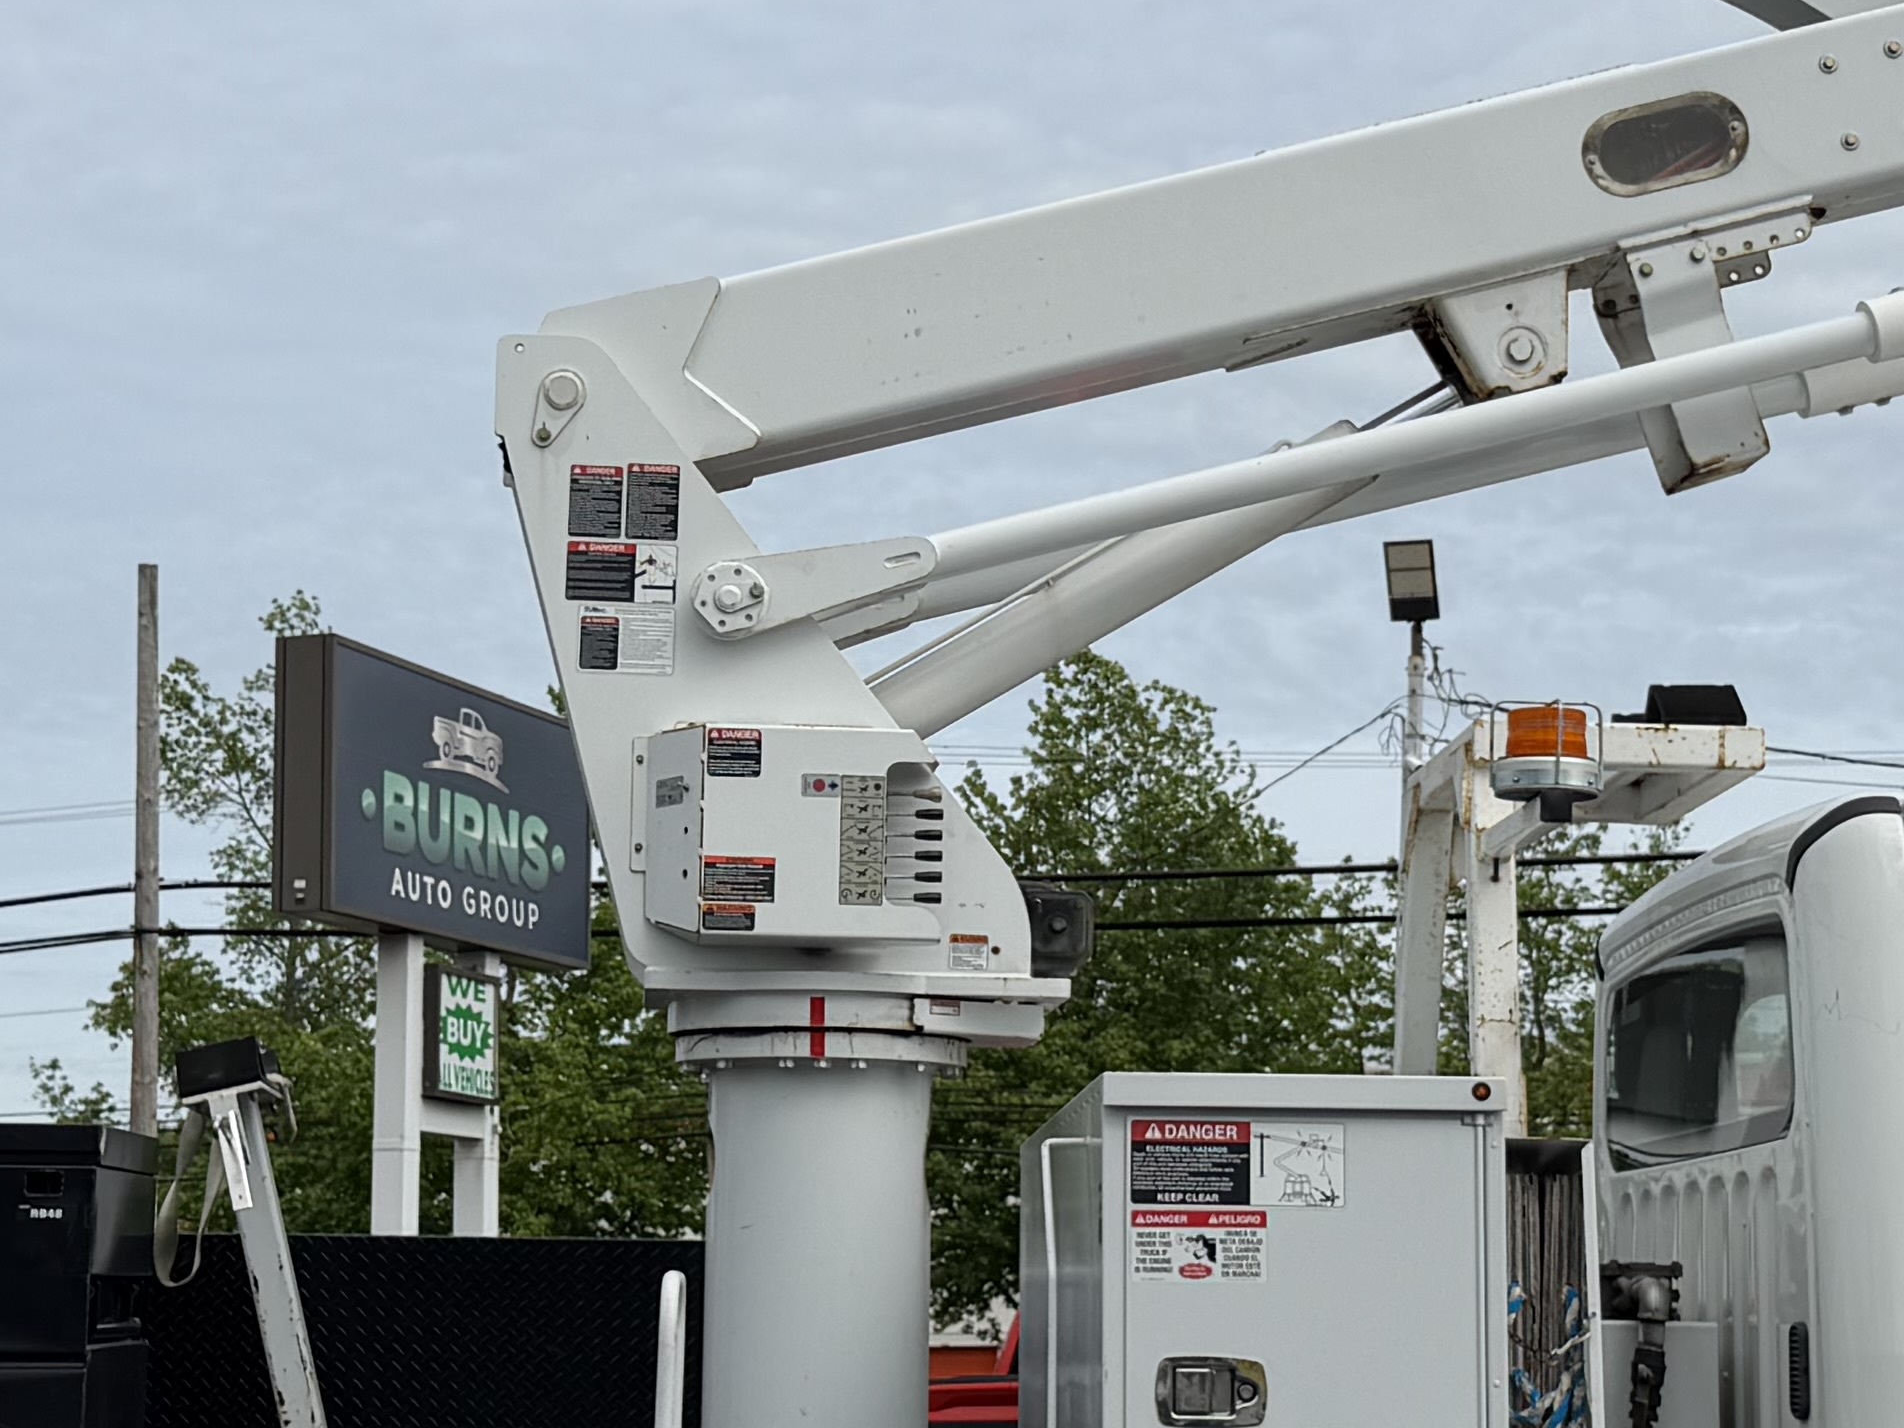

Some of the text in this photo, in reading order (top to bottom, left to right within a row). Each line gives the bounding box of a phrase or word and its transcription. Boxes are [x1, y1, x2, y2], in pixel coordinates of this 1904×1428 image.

[643, 464, 679, 474] DANGER
[589, 543, 625, 554] DANGER
[721, 730, 760, 740] DANGER
[382, 769, 550, 893] BURNS
[391, 867, 540, 930] AUTO GROUP
[447, 974, 486, 1004] WE
[447, 1015, 486, 1049] BUY
[1164, 1124, 1237, 1141] DANGER
[1146, 1145, 1191, 1153] ELECTRICAL
[1157, 1192, 1220, 1203] KEEP CLEAR
[1146, 1214, 1188, 1224] DANGER
[1218, 1214, 1261, 1225] PELIGRO
